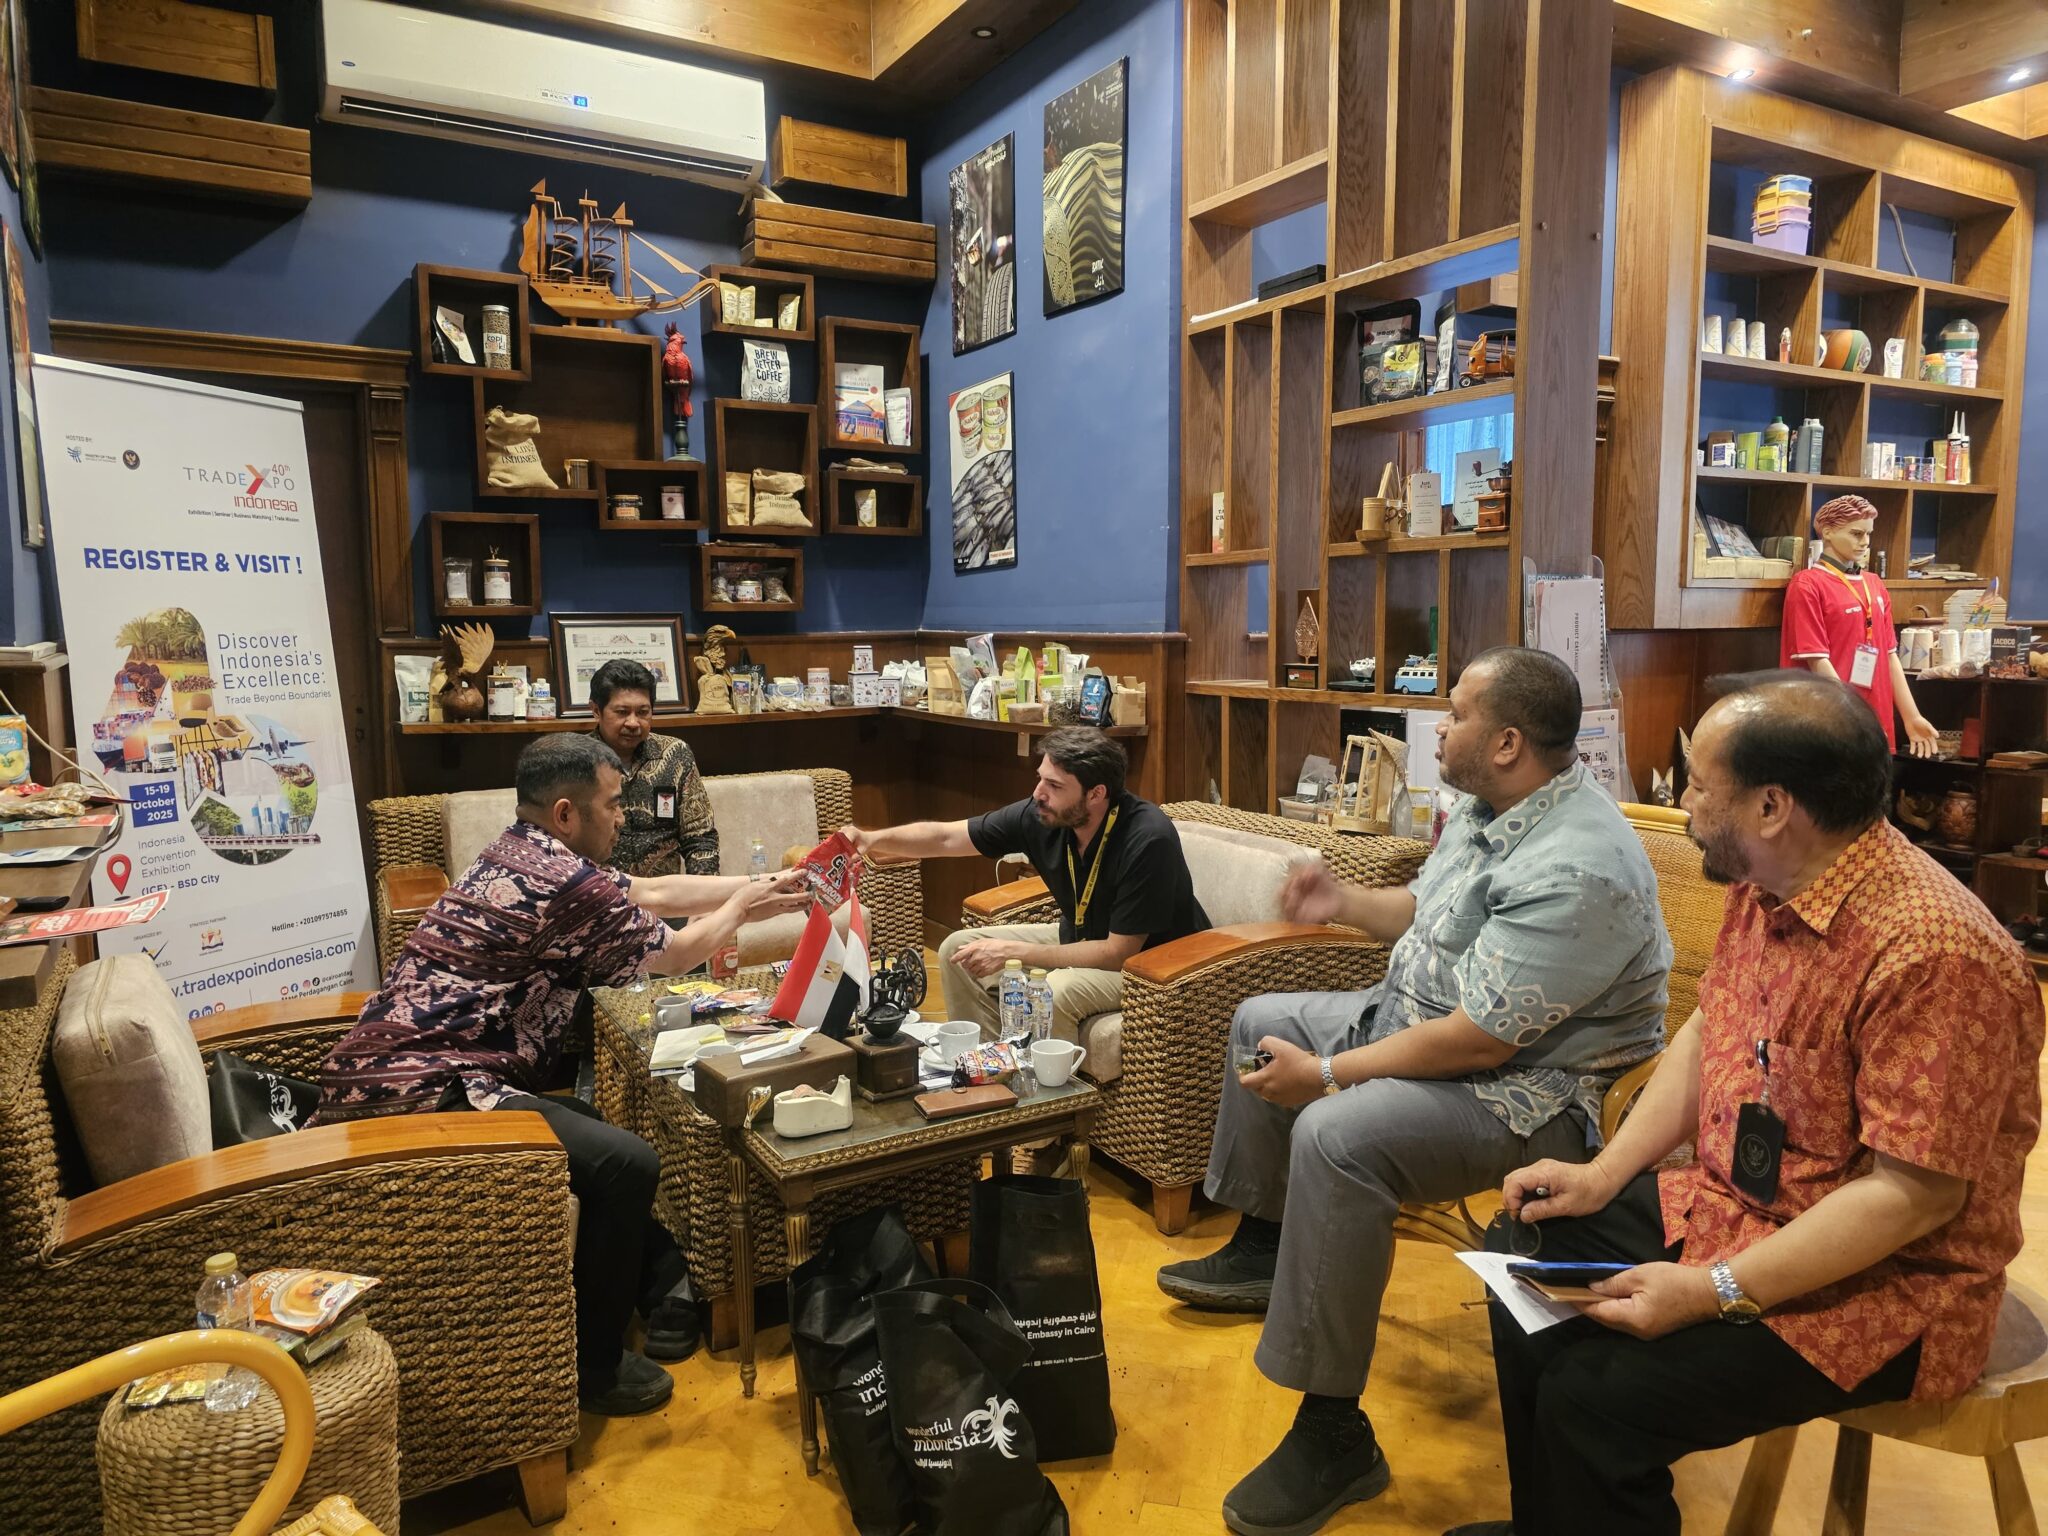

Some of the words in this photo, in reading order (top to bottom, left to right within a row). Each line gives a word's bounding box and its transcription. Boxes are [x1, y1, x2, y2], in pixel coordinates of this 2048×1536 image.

[754, 349, 778, 360] BREW
[754, 359, 781, 370] BETTER
[756, 369, 783, 382] COFFEE
[272, 463, 291, 476] 40th
[234, 496, 298, 512] indonesia
[84, 548, 208, 571] REGISTER
[215, 553, 230, 572] &
[235, 554, 290, 573] VISIT
[218, 633, 298, 650] Discover
[220, 651, 322, 670] Indonesia's
[223, 671, 326, 690] Excellence:
[226, 695, 251, 705] Trade
[253, 692, 286, 703] Beyond
[288, 689, 331, 700] Boundaries
[144, 784, 170, 796] 15-19
[133, 797, 175, 811] October
[147, 810, 173, 821] 2025
[138, 835, 185, 849] Indonesia
[140, 849, 196, 866] Convention
[141, 863, 191, 878] Exhibition
[177, 878, 198, 889] BSD
[201, 874, 220, 884] City
[272, 922, 294, 932] Hotline
[299, 982, 339, 998] Perdagangan
[1043, 1315, 1079, 1326] جمهورية
[1027, 1328, 1063, 1340] Embassy
[1064, 1328, 1073, 1336] in
[1074, 1326, 1096, 1335] Cairo
[905, 1417, 953, 1436] wonderful
[913, 1431, 981, 1452] indonesia
